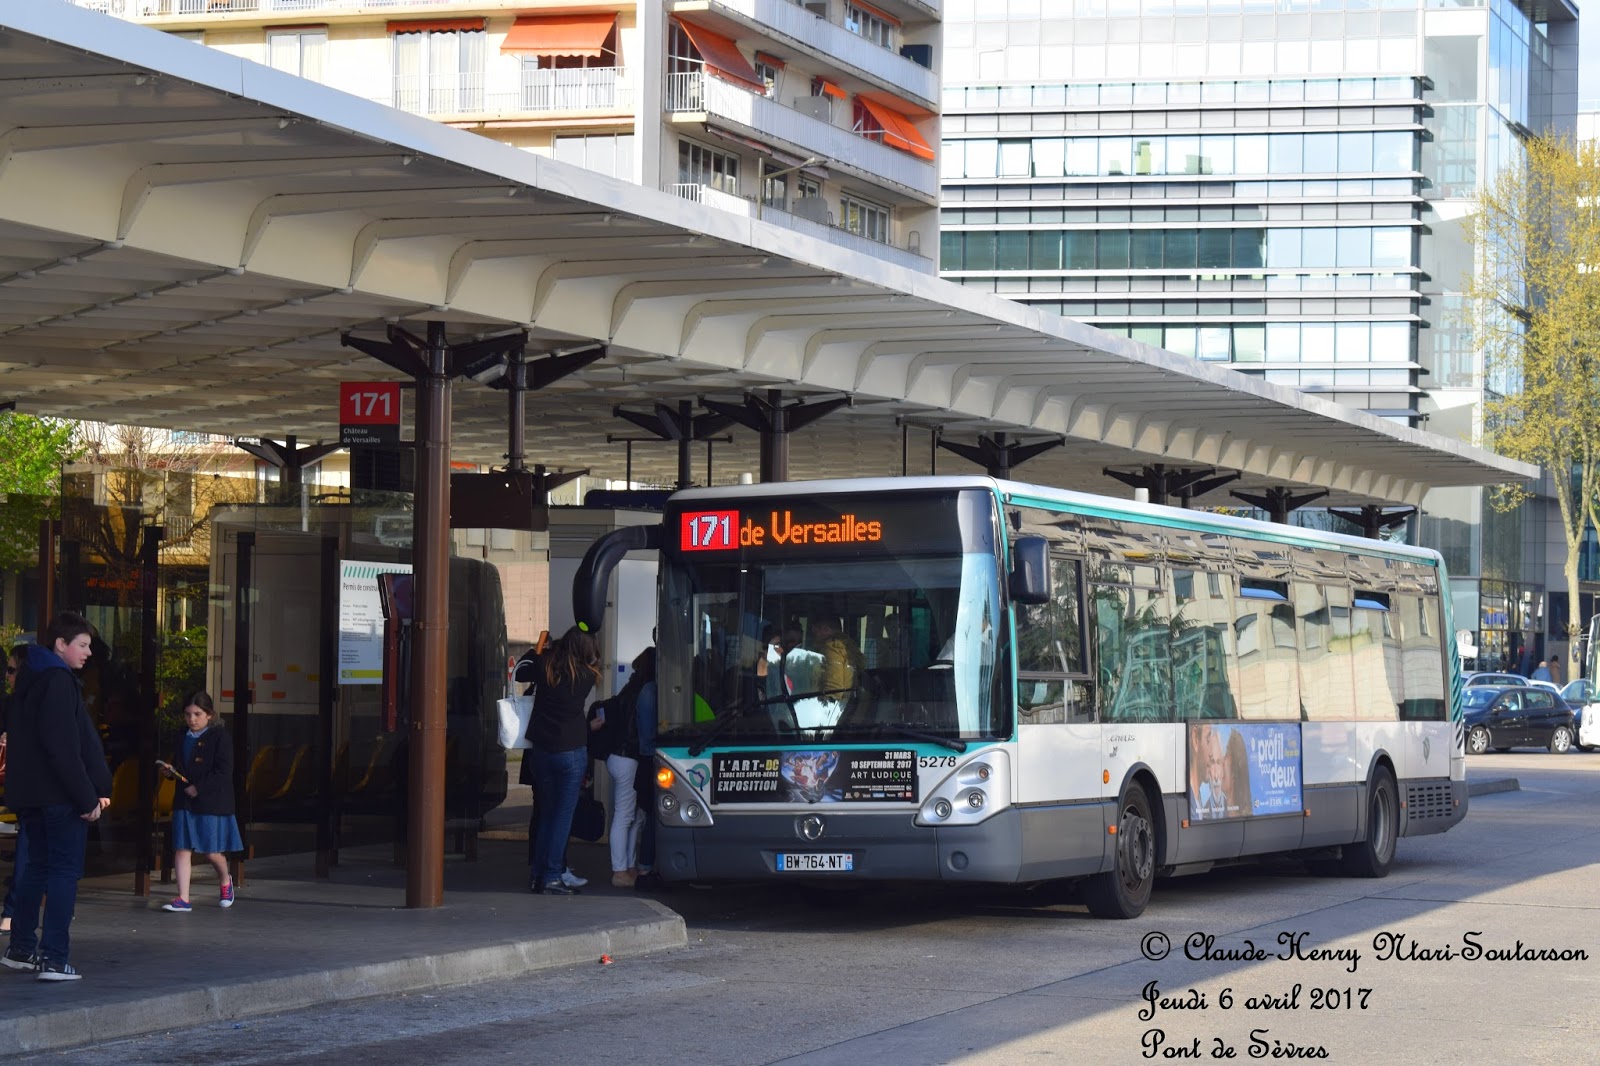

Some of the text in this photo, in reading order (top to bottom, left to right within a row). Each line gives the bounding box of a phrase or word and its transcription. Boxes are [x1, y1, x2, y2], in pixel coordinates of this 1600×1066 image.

[349, 392, 391, 416] 171
[689, 515, 729, 547] 171
[740, 511, 881, 545] de Versailles
[343, 582, 357, 591] Permis
[357, 583, 362, 591] de
[884, 751, 912, 759] 31 MARS
[1257, 732, 1284, 768] profil
[719, 758, 780, 771] L'ART DC
[850, 760, 912, 769] 10 SEPTEMBRE 2017
[919, 756, 957, 768] 5278
[850, 771, 912, 779] ART LUDIQUE
[1270, 760, 1297, 788] deux
[717, 780, 778, 791] EXPOSITION
[786, 855, 843, 868] BW-764-NT
